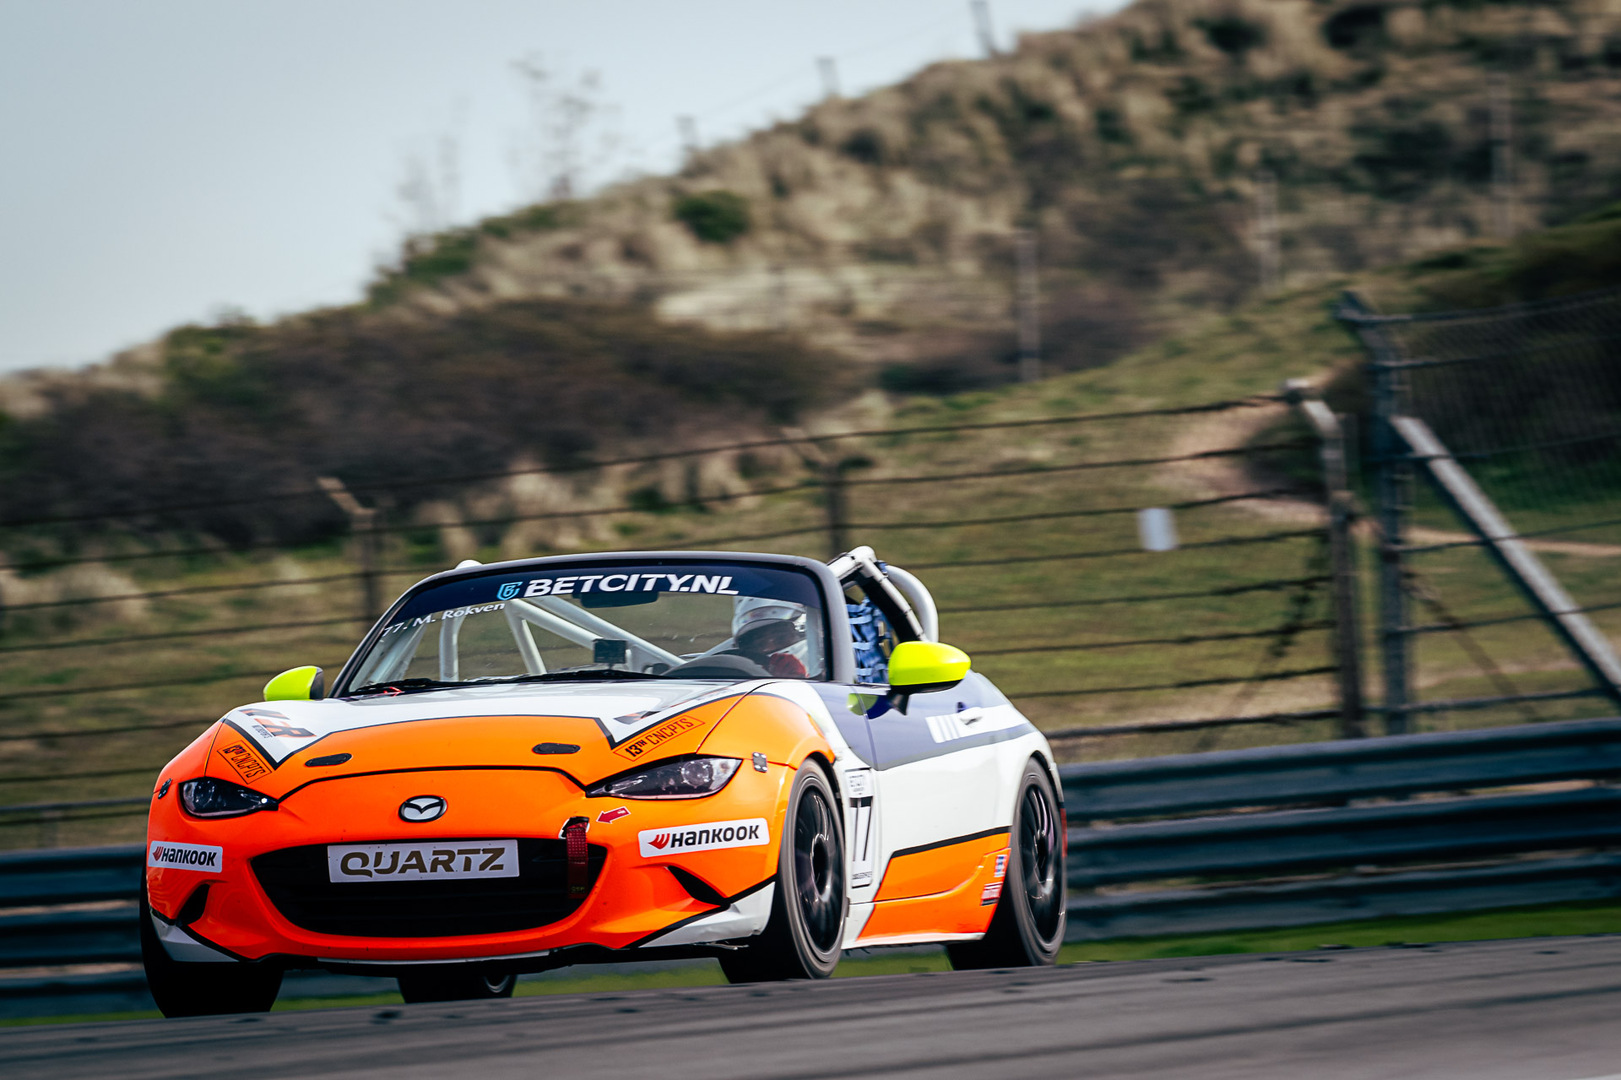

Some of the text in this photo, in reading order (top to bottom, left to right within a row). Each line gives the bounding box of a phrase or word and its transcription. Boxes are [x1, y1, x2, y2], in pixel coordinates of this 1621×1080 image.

[524, 574, 739, 597] BETCITY.NL
[412, 614, 436, 627] M.
[441, 603, 506, 620] Rokven
[645, 718, 694, 746] CNCPTS
[340, 847, 505, 878] QUARTZ
